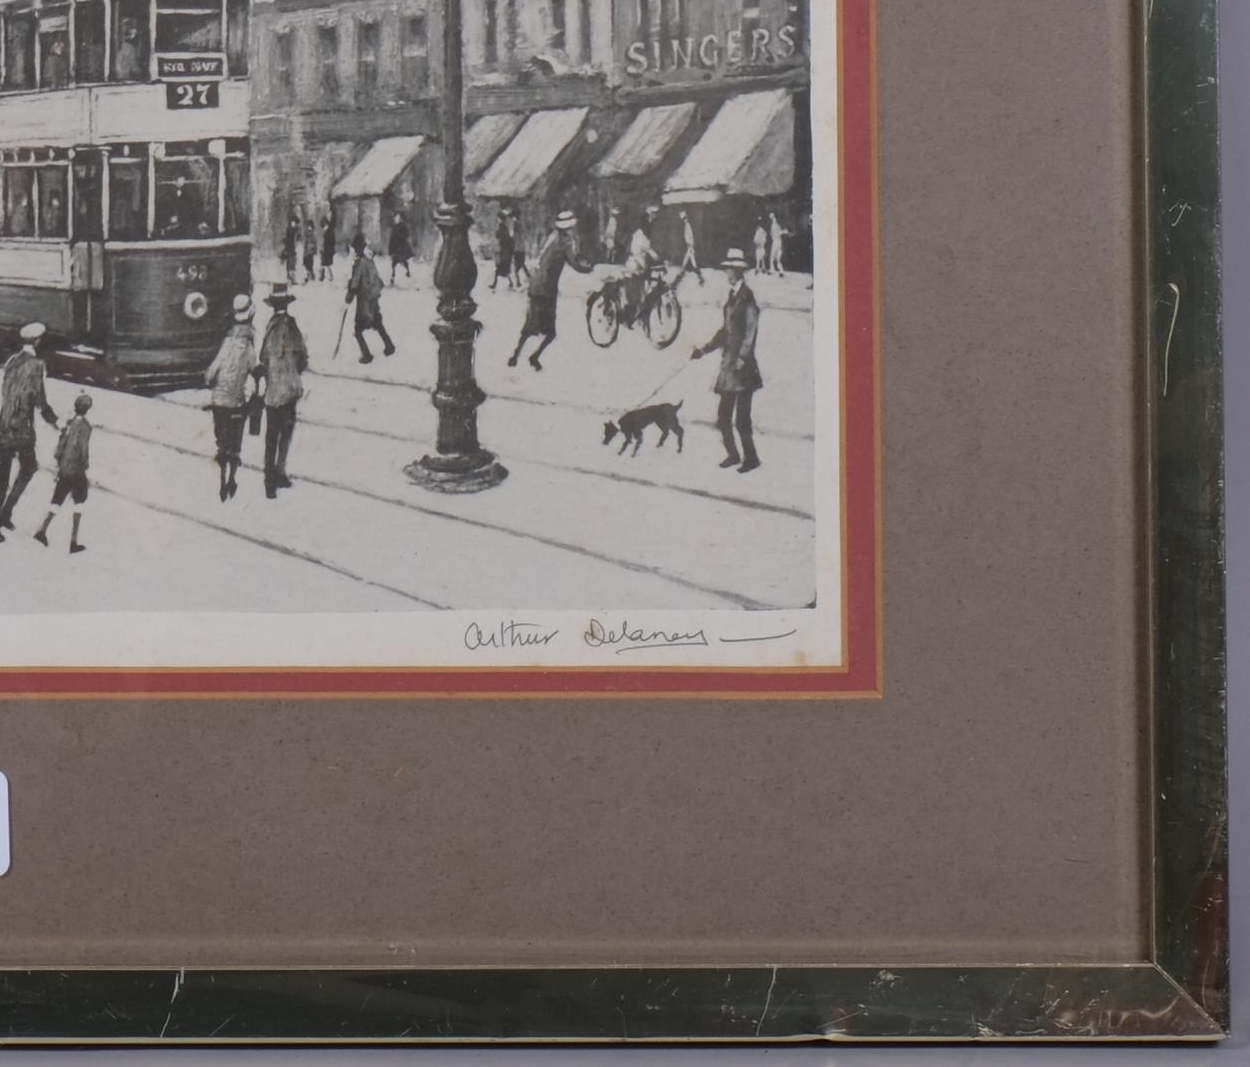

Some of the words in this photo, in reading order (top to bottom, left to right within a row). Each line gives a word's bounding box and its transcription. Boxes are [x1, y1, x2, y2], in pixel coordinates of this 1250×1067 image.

[626, 25, 796, 74] SINGERS
[177, 84, 211, 105] 27
[464, 621, 559, 651] Arthur
